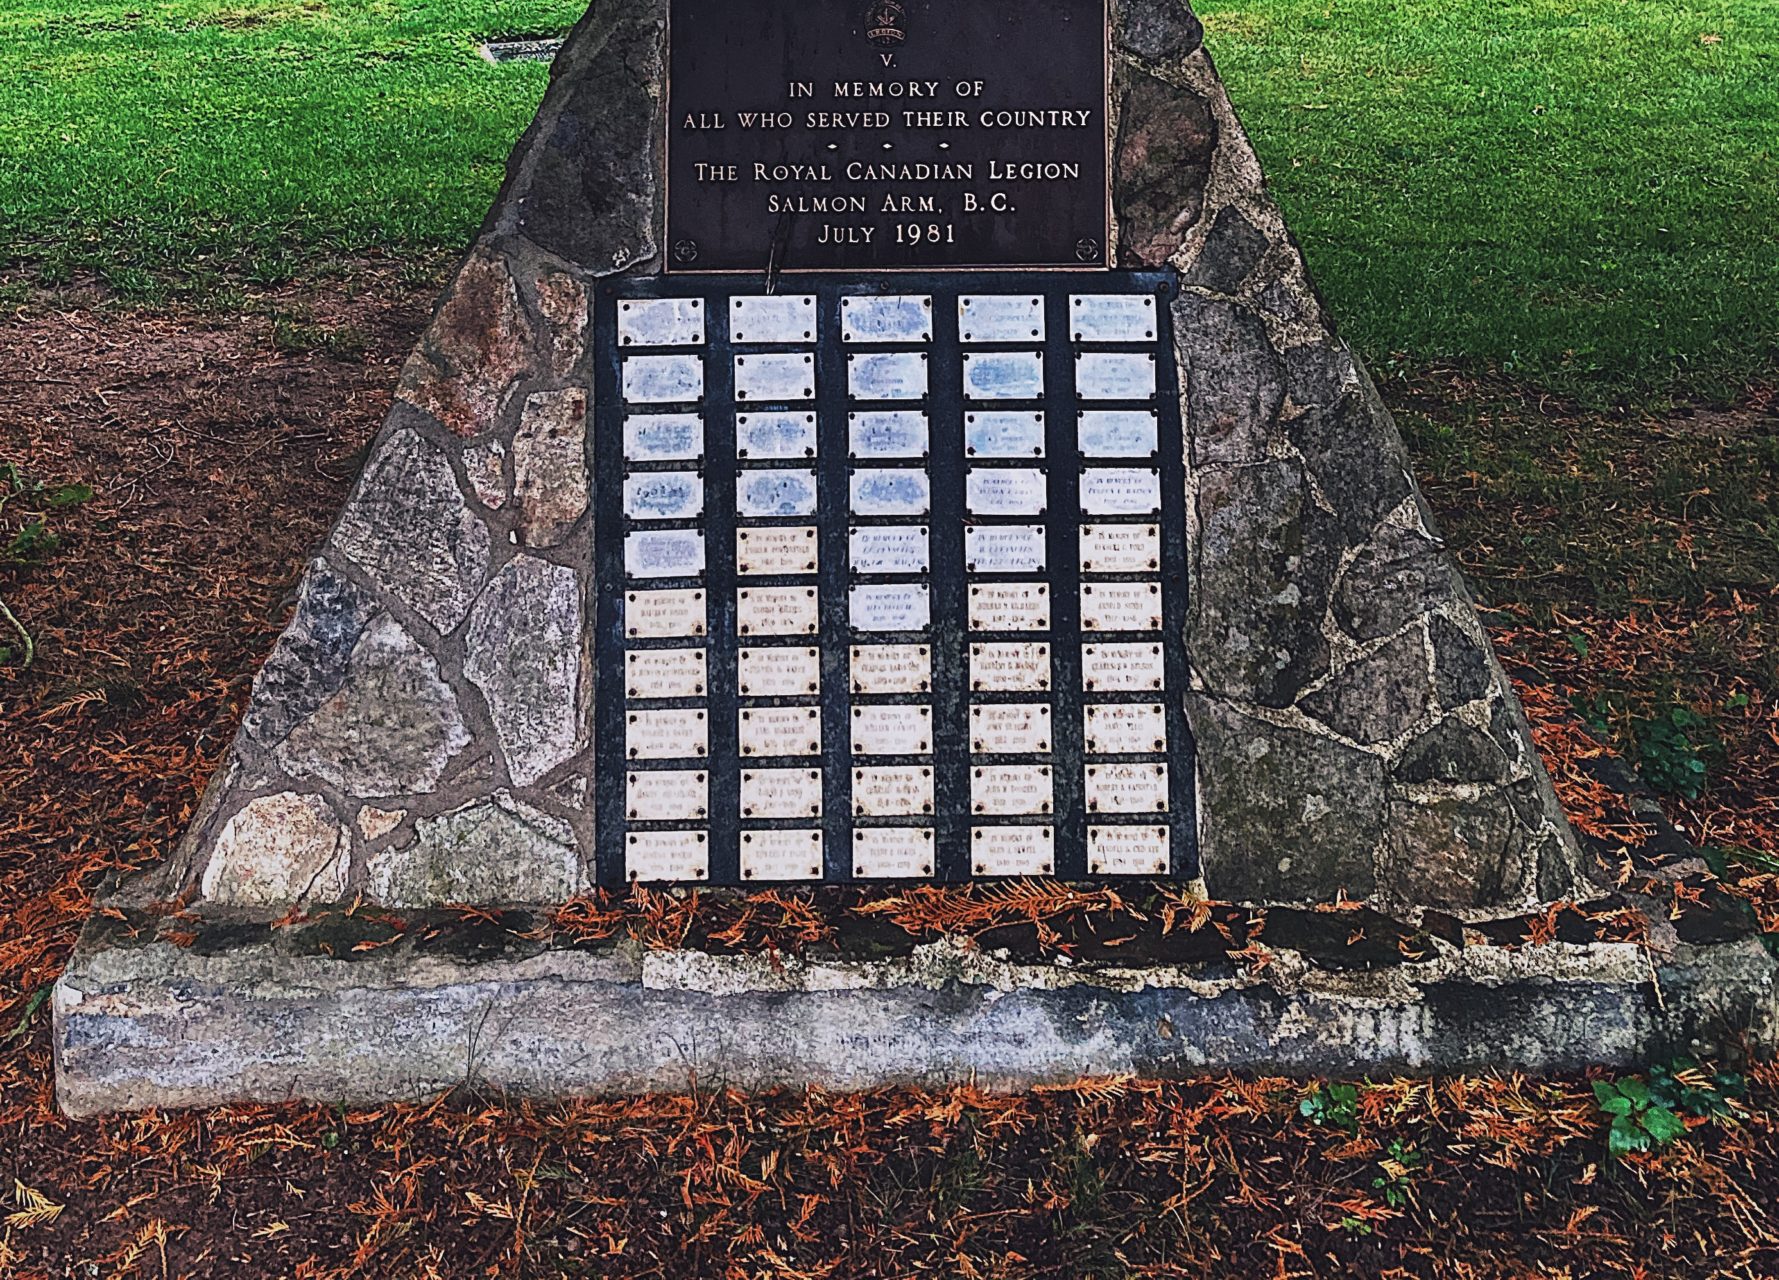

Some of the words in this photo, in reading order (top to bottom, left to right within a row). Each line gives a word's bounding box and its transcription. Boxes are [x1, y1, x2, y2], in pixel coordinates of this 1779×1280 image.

[789, 82, 813, 98] IN
[834, 81, 939, 97] MEMORY
[955, 80, 984, 97] OF
[683, 113, 725, 129] ALL
[737, 112, 793, 128] WHO
[806, 112, 890, 128] SERVED
[902, 111, 970, 127] THEIR
[980, 110, 1091, 128] COUNTRY
[694, 163, 738, 181] THE
[753, 162, 832, 181] ROYAL
[846, 161, 973, 181] CANADIAN
[989, 160, 1079, 180] LEGION
[768, 194, 866, 213] SALMON
[880, 193, 943, 214] ARM,
[964, 192, 1016, 212] B.C.
[817, 224, 875, 244] JULY
[896, 223, 954, 246] 1981
